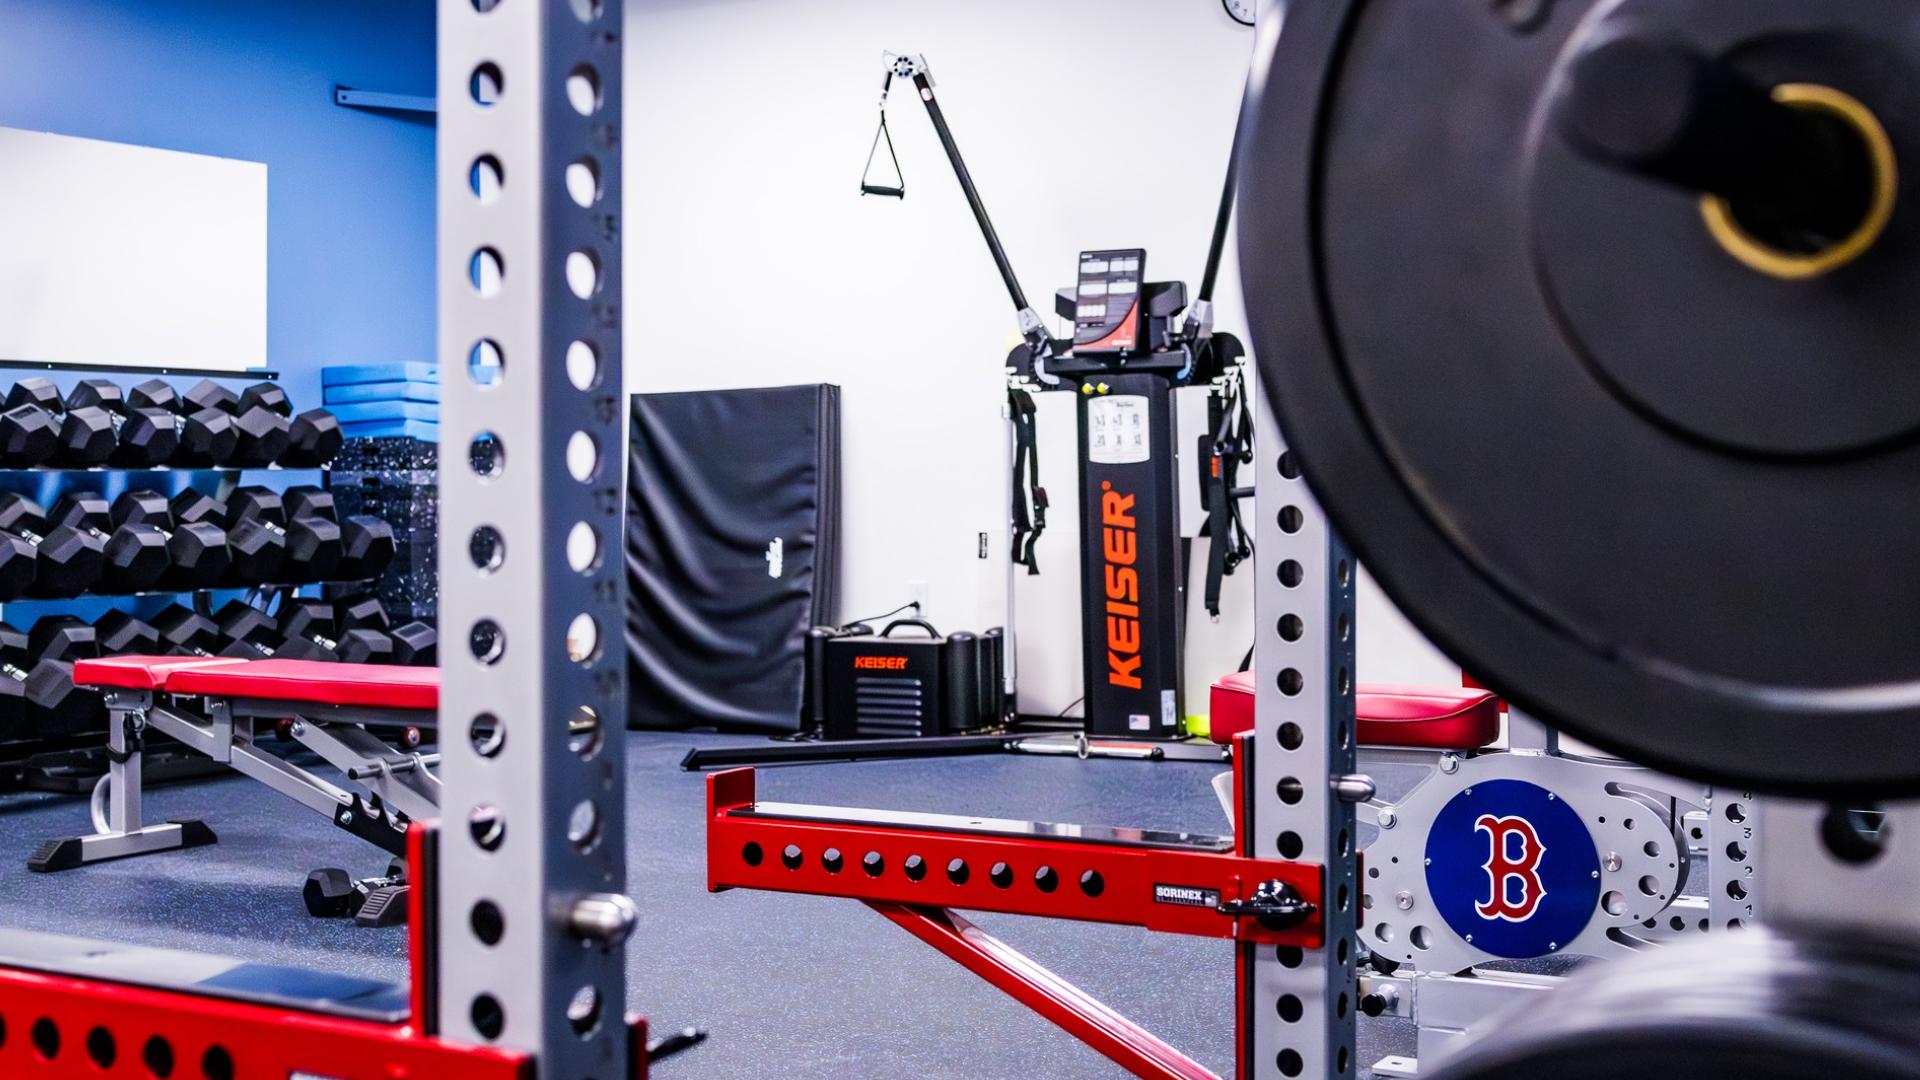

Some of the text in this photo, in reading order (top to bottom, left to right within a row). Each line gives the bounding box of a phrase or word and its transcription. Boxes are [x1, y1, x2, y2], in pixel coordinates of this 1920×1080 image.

[1102, 490, 1143, 690] KEISER
[855, 656, 908, 669] KEISER
[1743, 827, 1753, 839] 3
[1474, 814, 1548, 923] B
[1744, 866, 1753, 878] 2
[1156, 887, 1203, 901] SORINEX
[1745, 904, 1753, 917] 1
